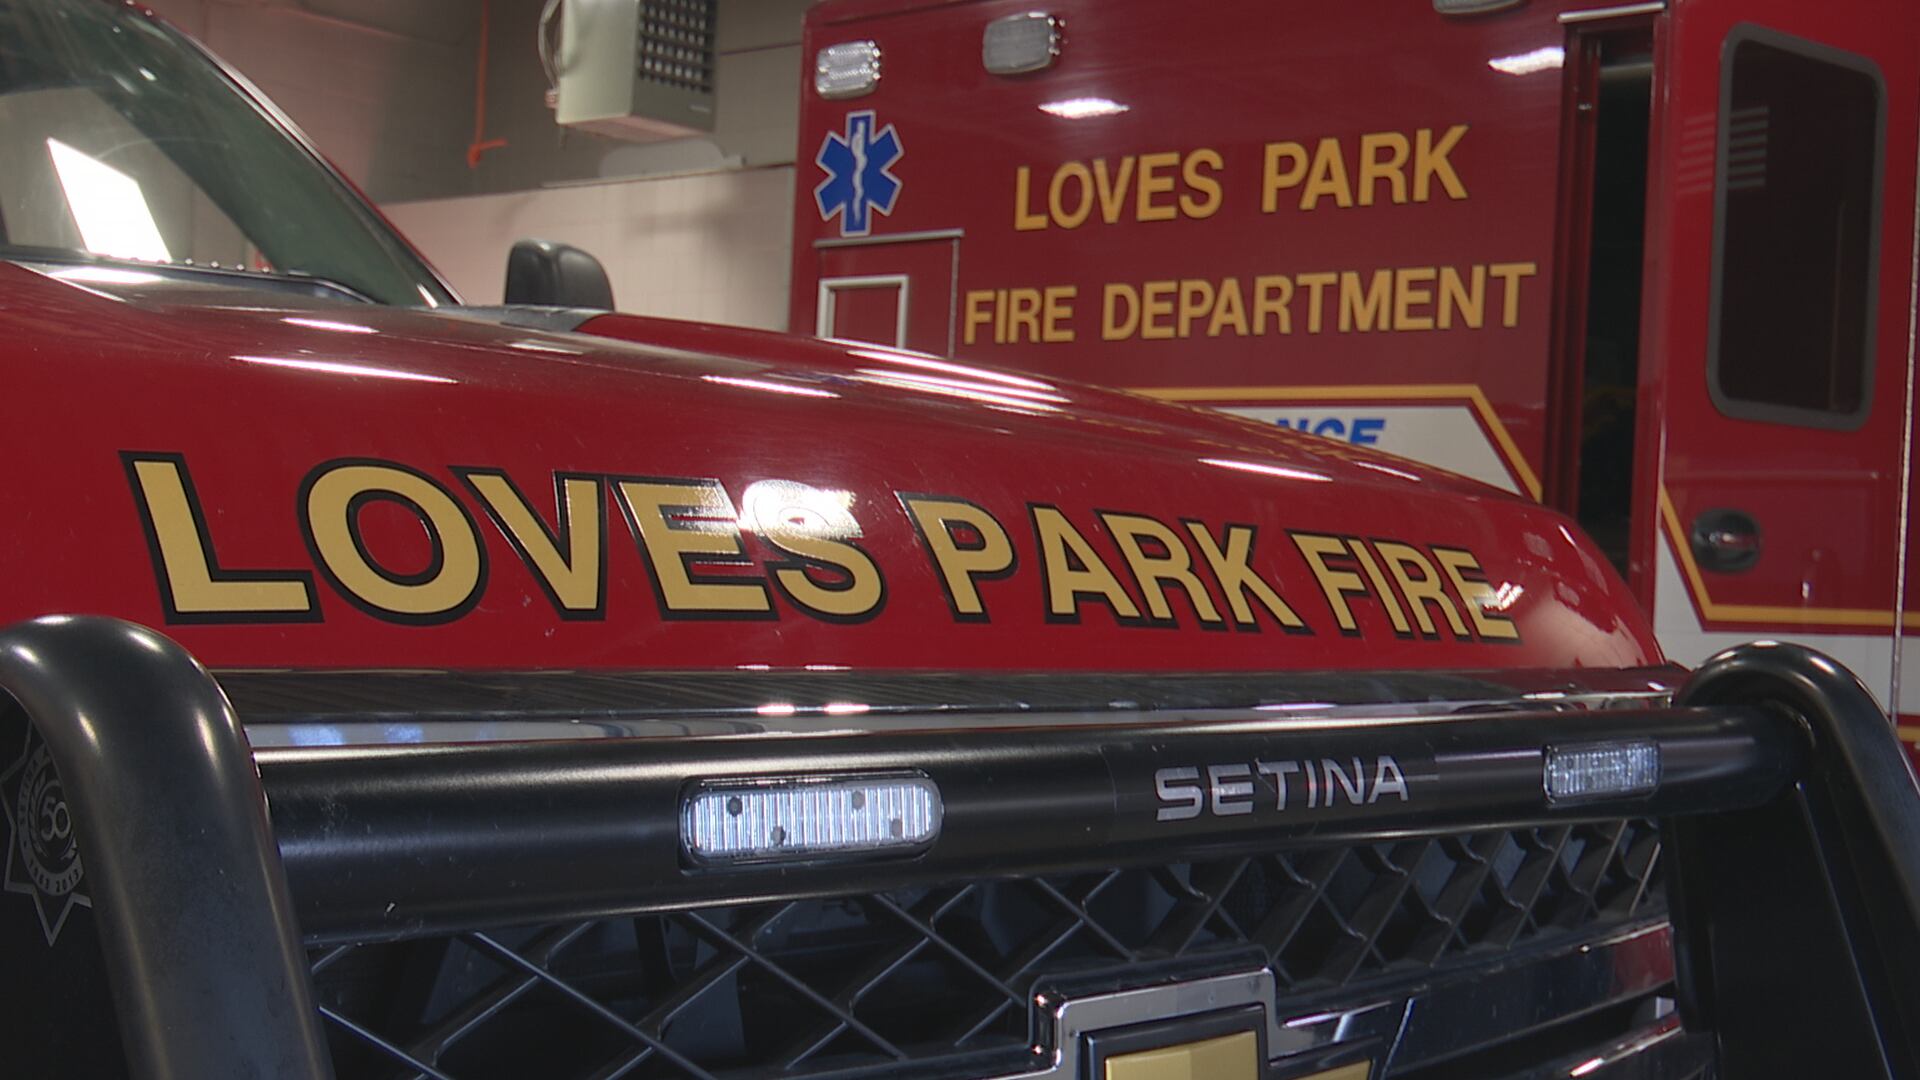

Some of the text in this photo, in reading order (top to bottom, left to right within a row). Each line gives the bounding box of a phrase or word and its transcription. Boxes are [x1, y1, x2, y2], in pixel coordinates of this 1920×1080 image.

[1014, 124, 1469, 231] LOVES PARK
[963, 262, 1537, 345] FIRE DEPARTMENT
[121, 451, 1524, 645] LOVES PARK FIRE
[40, 797, 71, 842] 50
[1155, 756, 1409, 821] SETINA
